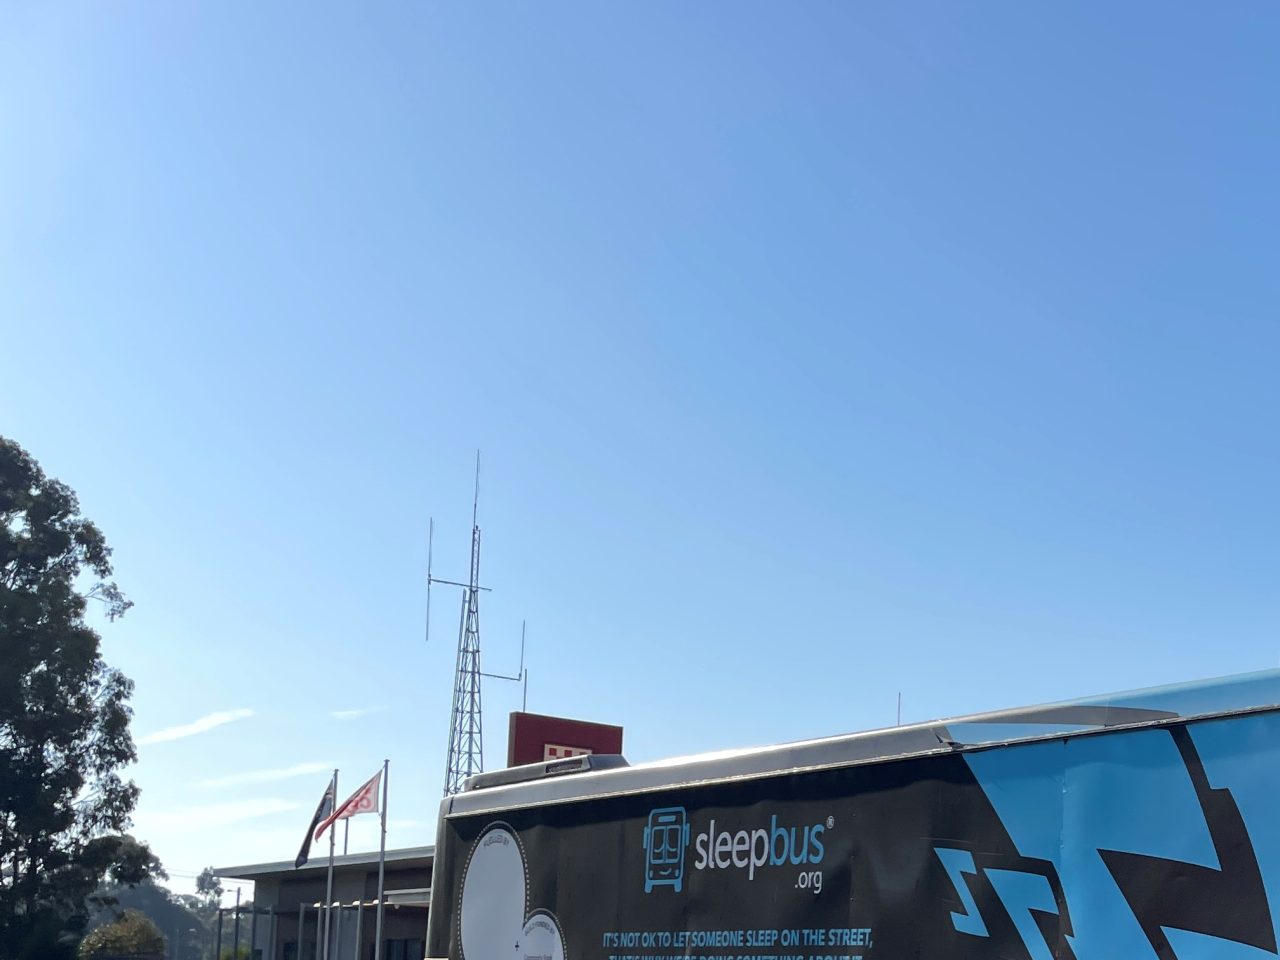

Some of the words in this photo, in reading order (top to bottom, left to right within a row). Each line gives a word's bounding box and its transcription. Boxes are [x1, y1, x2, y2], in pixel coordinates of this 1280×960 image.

[794, 871, 823, 894] .org
[603, 932, 619, 947] IT'S
[620, 932, 641, 948] NOT
[642, 932, 657, 948] OK
[658, 932, 672, 948] TO
[673, 932, 692, 947] LET
[691, 930, 744, 947] SOMEONE
[746, 930, 779, 947] SLEEP
[781, 929, 800, 947] ON
[802, 929, 826, 946] THE
[828, 928, 873, 949] STREET,
